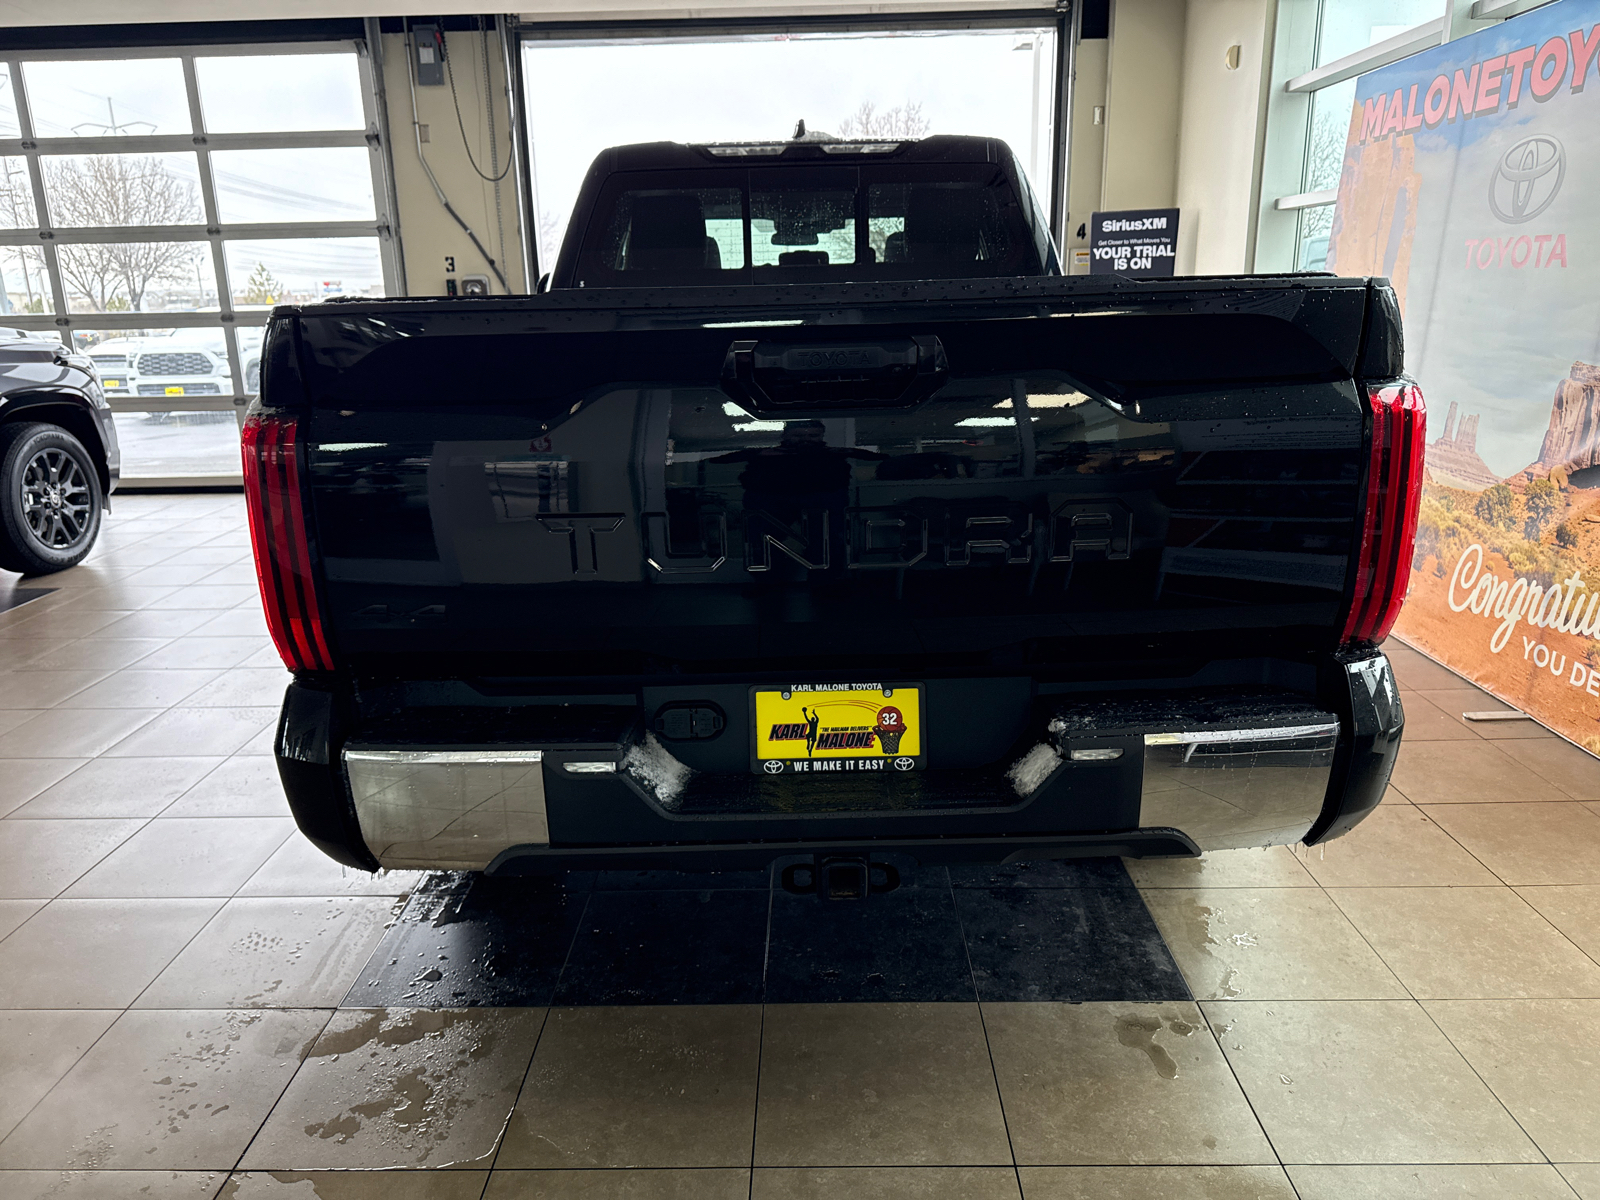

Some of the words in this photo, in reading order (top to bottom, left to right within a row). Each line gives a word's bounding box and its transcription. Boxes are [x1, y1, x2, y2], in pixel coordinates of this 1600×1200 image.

[1359, 24, 1600, 144] MALONETOY
[1076, 222, 1087, 240] 4
[1102, 217, 1167, 232] SiriusXM
[1093, 246, 1131, 260] YOUR
[1133, 244, 1175, 257] TRIAL
[1464, 233, 1568, 270] TOYOTA
[445, 256, 455, 272] 3
[1114, 258, 1128, 270] IS
[1130, 257, 1152, 270] ON
[798, 351, 872, 367] TOYOTA
[536, 498, 1135, 575] TUNDRA
[1448, 543, 1600, 654] Congratu
[1522, 636, 1566, 676] YOU
[791, 684, 813, 692] KARL
[815, 684, 849, 692] MALONE
[851, 683, 882, 691] TOYOTA
[882, 713, 897, 725] 32
[768, 723, 810, 741] KARL
[815, 731, 876, 750] MALONE
[793, 761, 809, 771] WE
[813, 760, 842, 771] MAKE
[846, 760, 855, 770] IT
[859, 759, 884, 770] EASY
